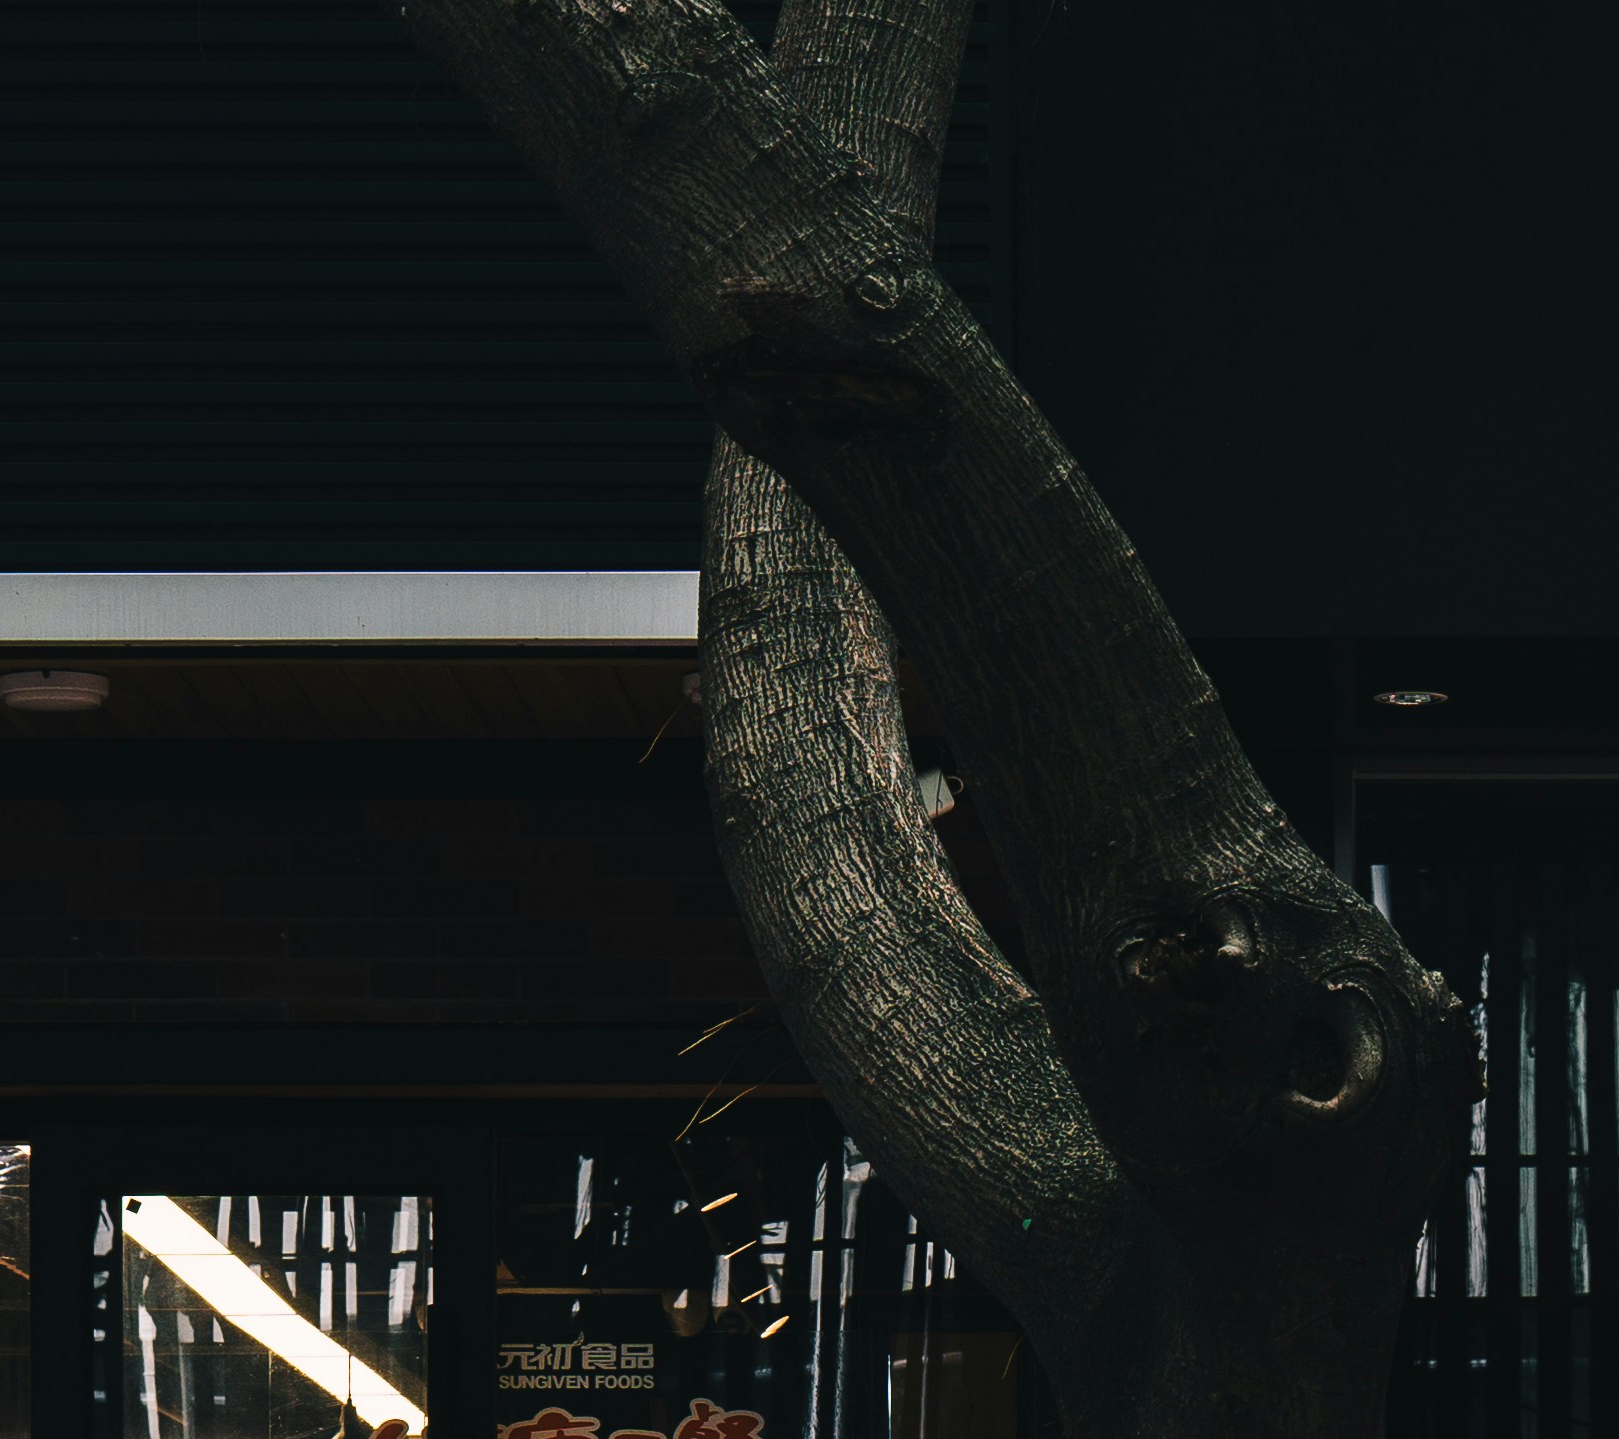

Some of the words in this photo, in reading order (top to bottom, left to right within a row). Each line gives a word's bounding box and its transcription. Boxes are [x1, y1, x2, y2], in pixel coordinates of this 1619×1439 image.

[497, 1340, 655, 1371] 元初食品
[499, 1374, 589, 1390] SUNGIVEN
[594, 1374, 655, 1390] FOODS
